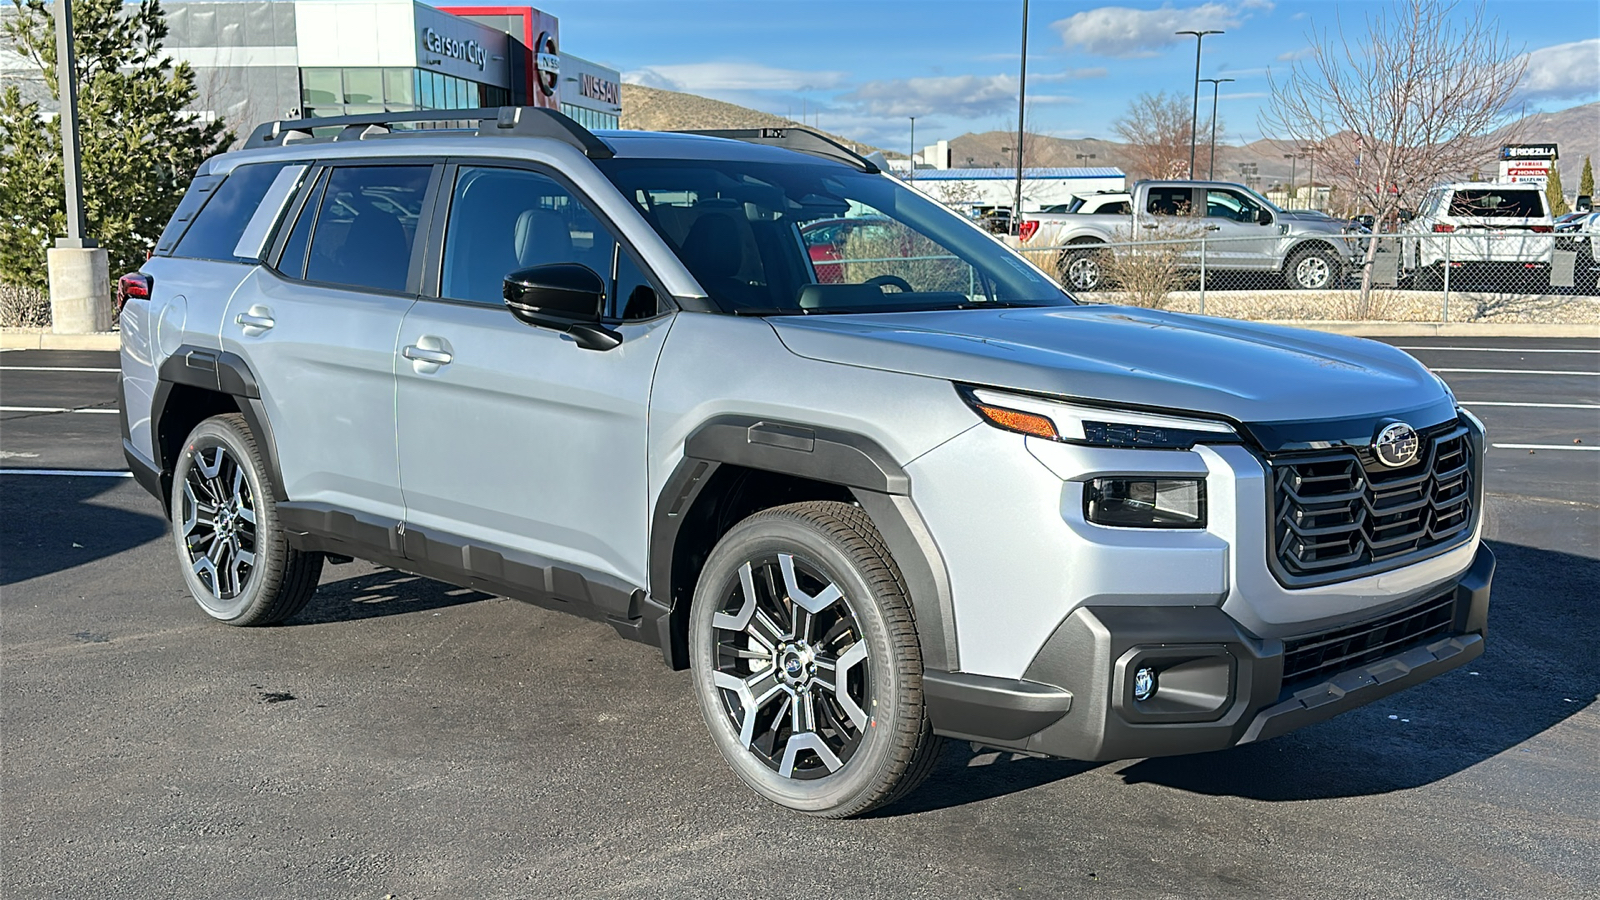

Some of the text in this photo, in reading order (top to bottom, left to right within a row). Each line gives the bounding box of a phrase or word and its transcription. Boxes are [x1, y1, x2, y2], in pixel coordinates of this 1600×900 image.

[425, 27, 488, 71] Carson City
[580, 73, 619, 105] NISSAN
[1517, 147, 1556, 156] RIDEZILLA
[865, 606, 893, 733] BRIDGESTONE
